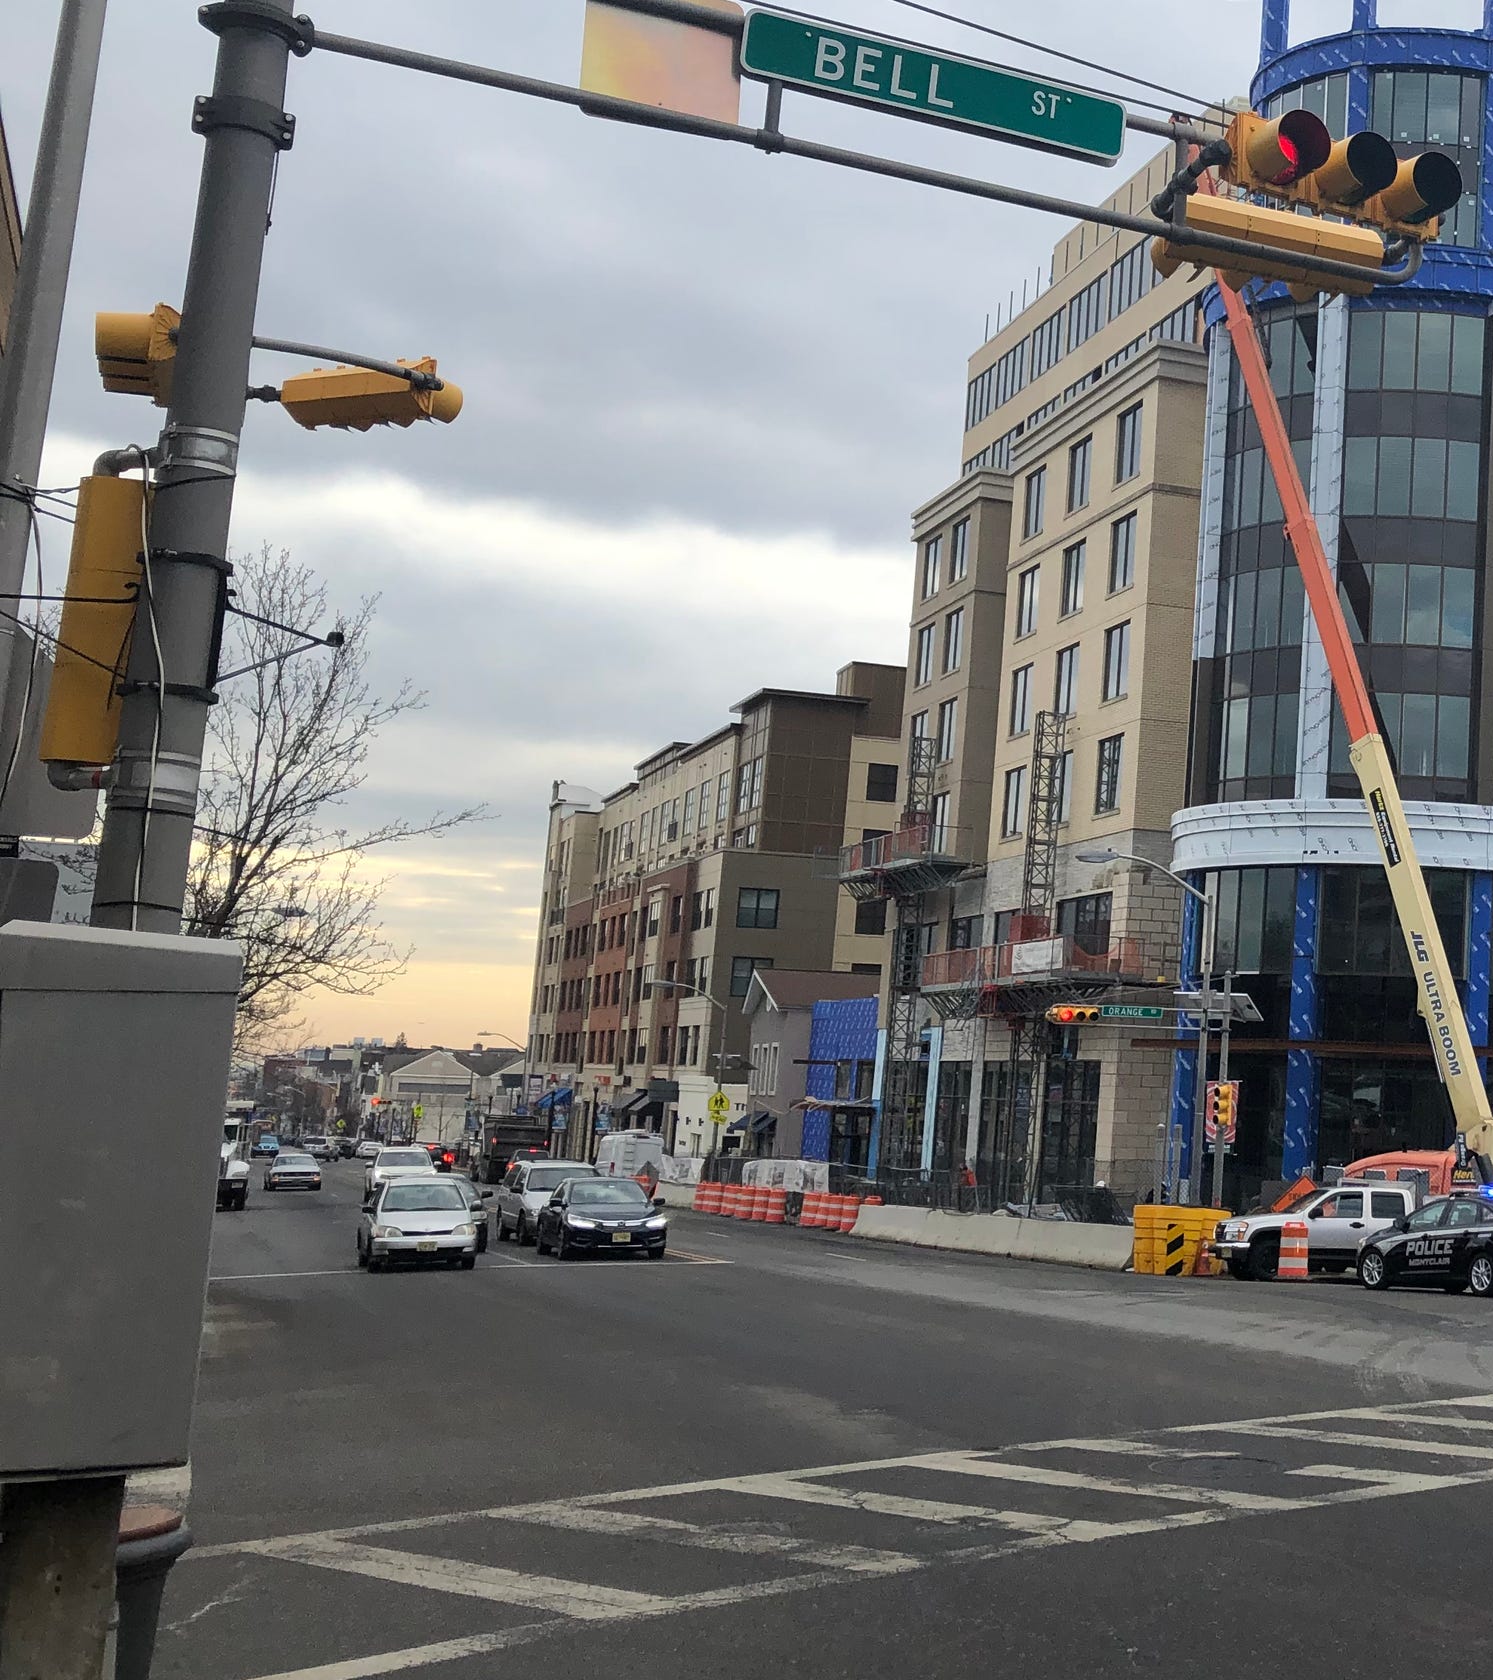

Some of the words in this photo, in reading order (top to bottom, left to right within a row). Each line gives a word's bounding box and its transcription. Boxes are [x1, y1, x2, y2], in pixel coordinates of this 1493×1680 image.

[814, 36, 955, 110] BELL
[1031, 90, 1062, 120] ST
[1108, 1007, 1144, 1016] ORANGE
[1410, 930, 1430, 963] JLG
[1423, 971, 1446, 1023] ULTRA
[1438, 1025, 1462, 1077] BOOM
[1459, 1144, 1467, 1167] Orange
[1406, 1239, 1455, 1256] POLICE
[1409, 1257, 1450, 1267] MONTCLAIR
